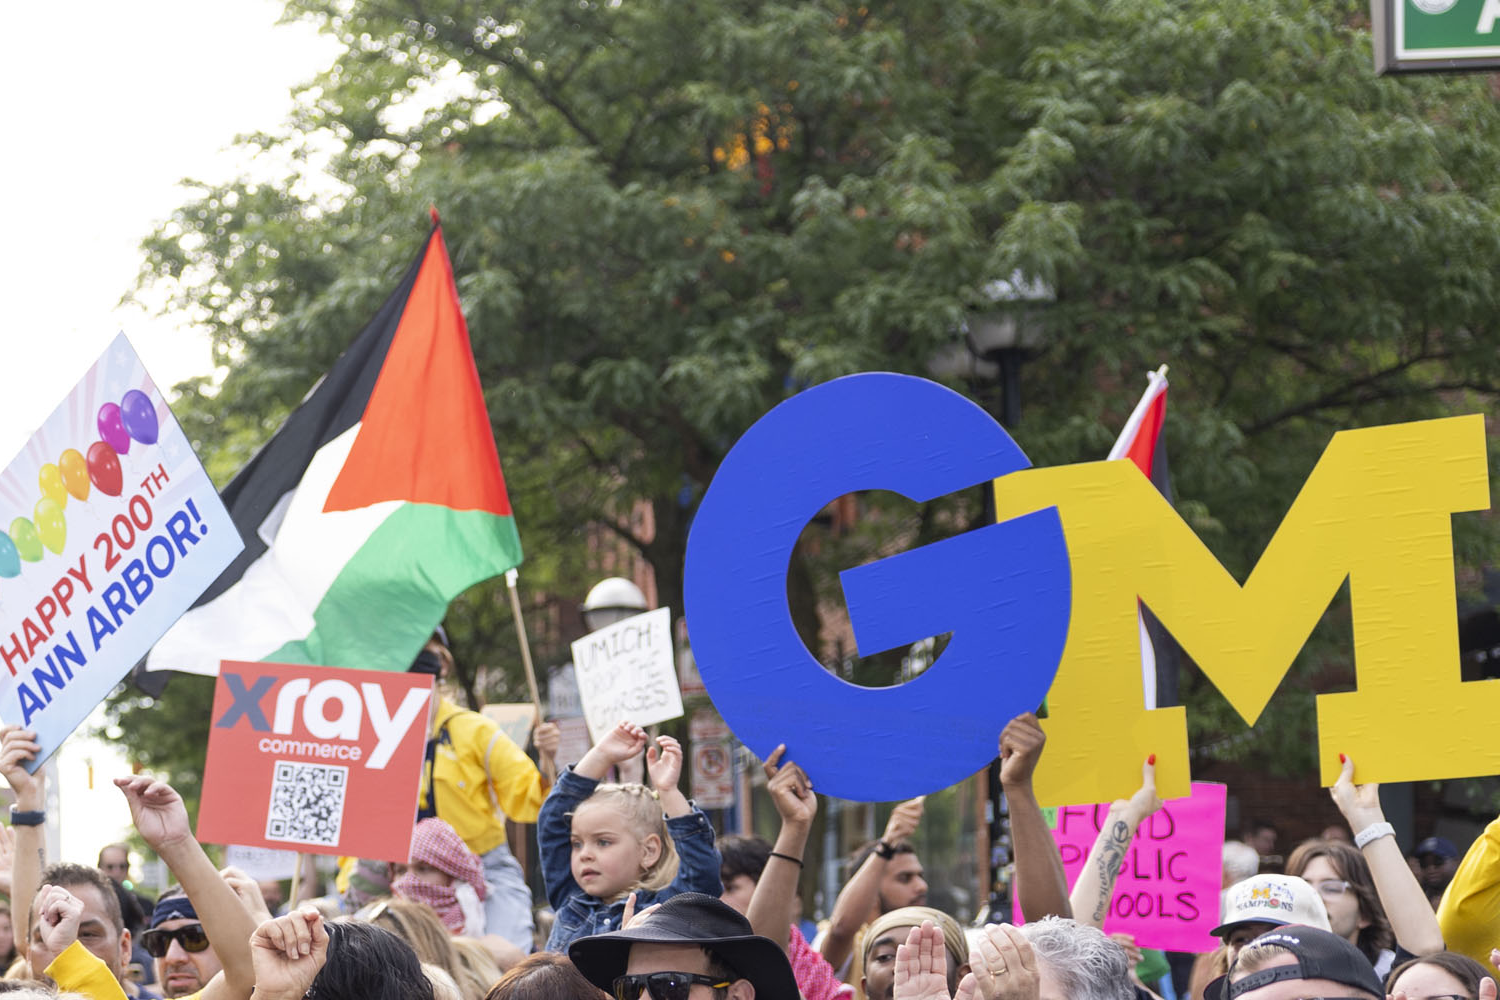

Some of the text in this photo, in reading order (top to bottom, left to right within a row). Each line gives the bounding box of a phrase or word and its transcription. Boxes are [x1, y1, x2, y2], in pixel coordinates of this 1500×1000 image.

[0, 463, 171, 677] HAPPY 200TH
[17, 497, 209, 726] ANN ARBOR!
[216, 673, 432, 770] xray
[258, 738, 363, 761] commerce
[1251, 887, 1271, 899] M
